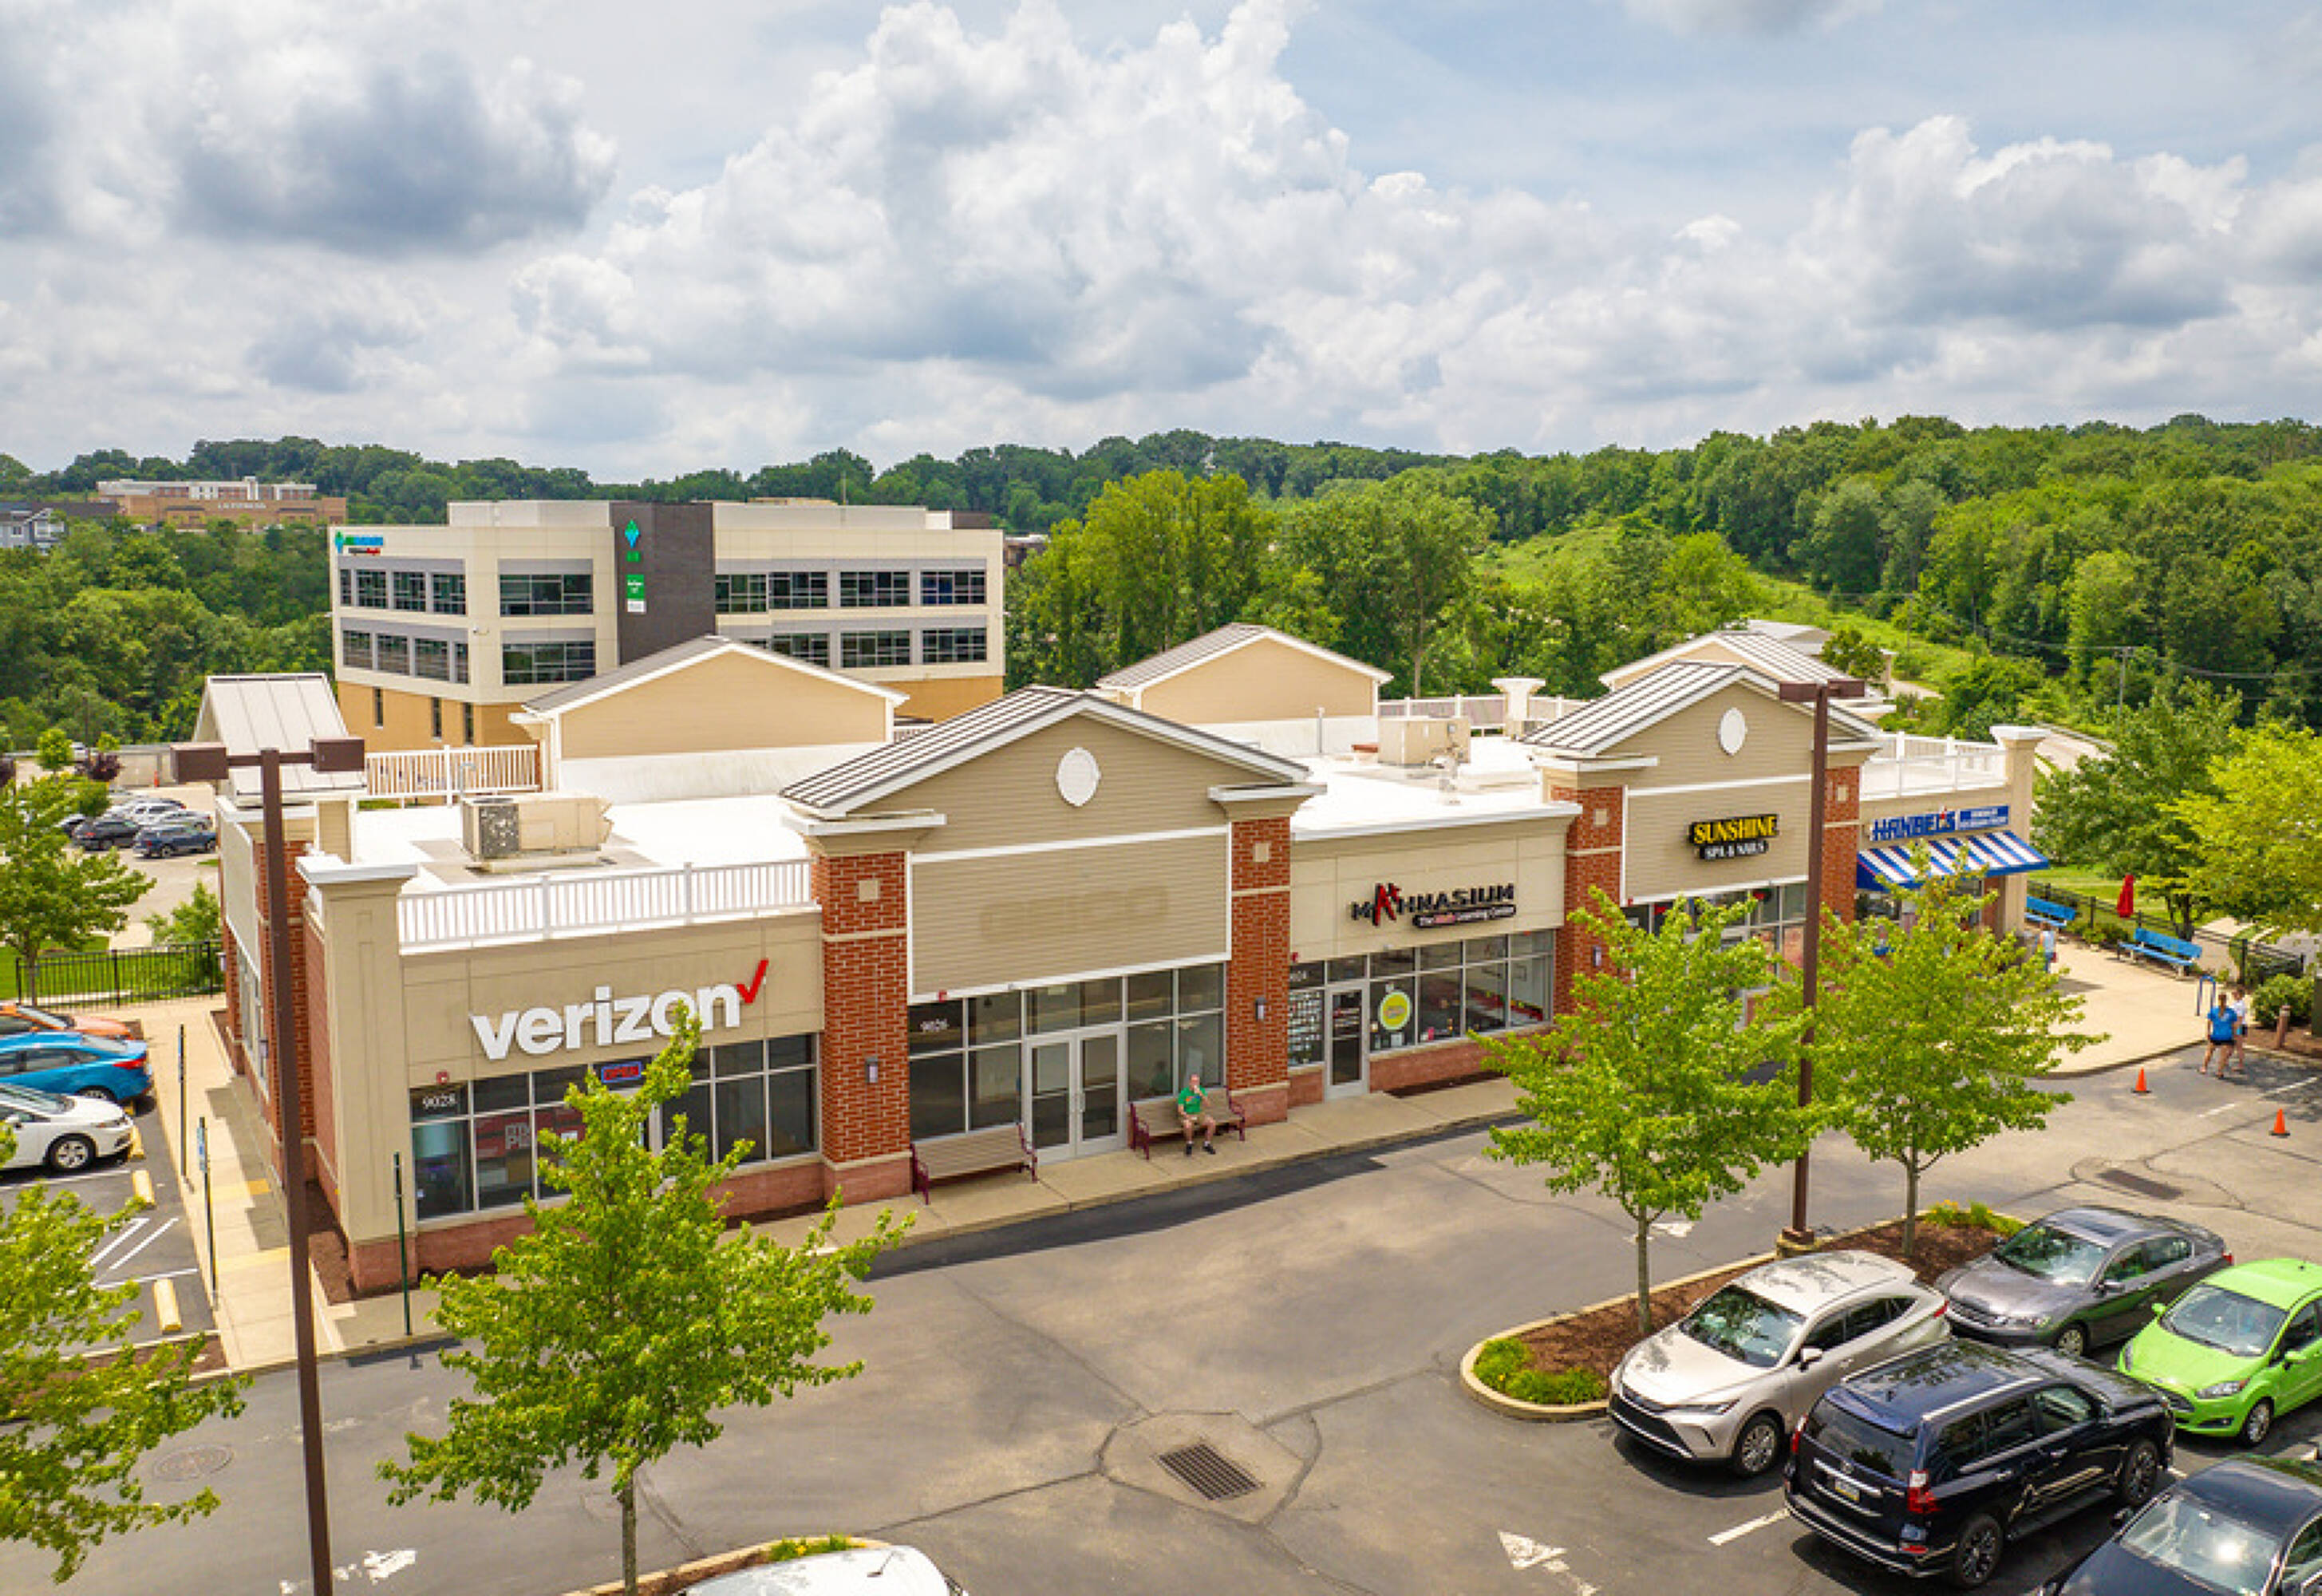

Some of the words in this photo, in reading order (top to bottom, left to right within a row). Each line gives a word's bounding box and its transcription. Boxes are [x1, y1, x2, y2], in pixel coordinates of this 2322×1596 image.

[1693, 816, 1778, 844] SUNSHINE
[1704, 846, 1724, 859] SPA
[1351, 883, 1514, 926] MATHNASIUM
[469, 983, 740, 1060] verizon
[603, 1065, 639, 1080] OPEN
